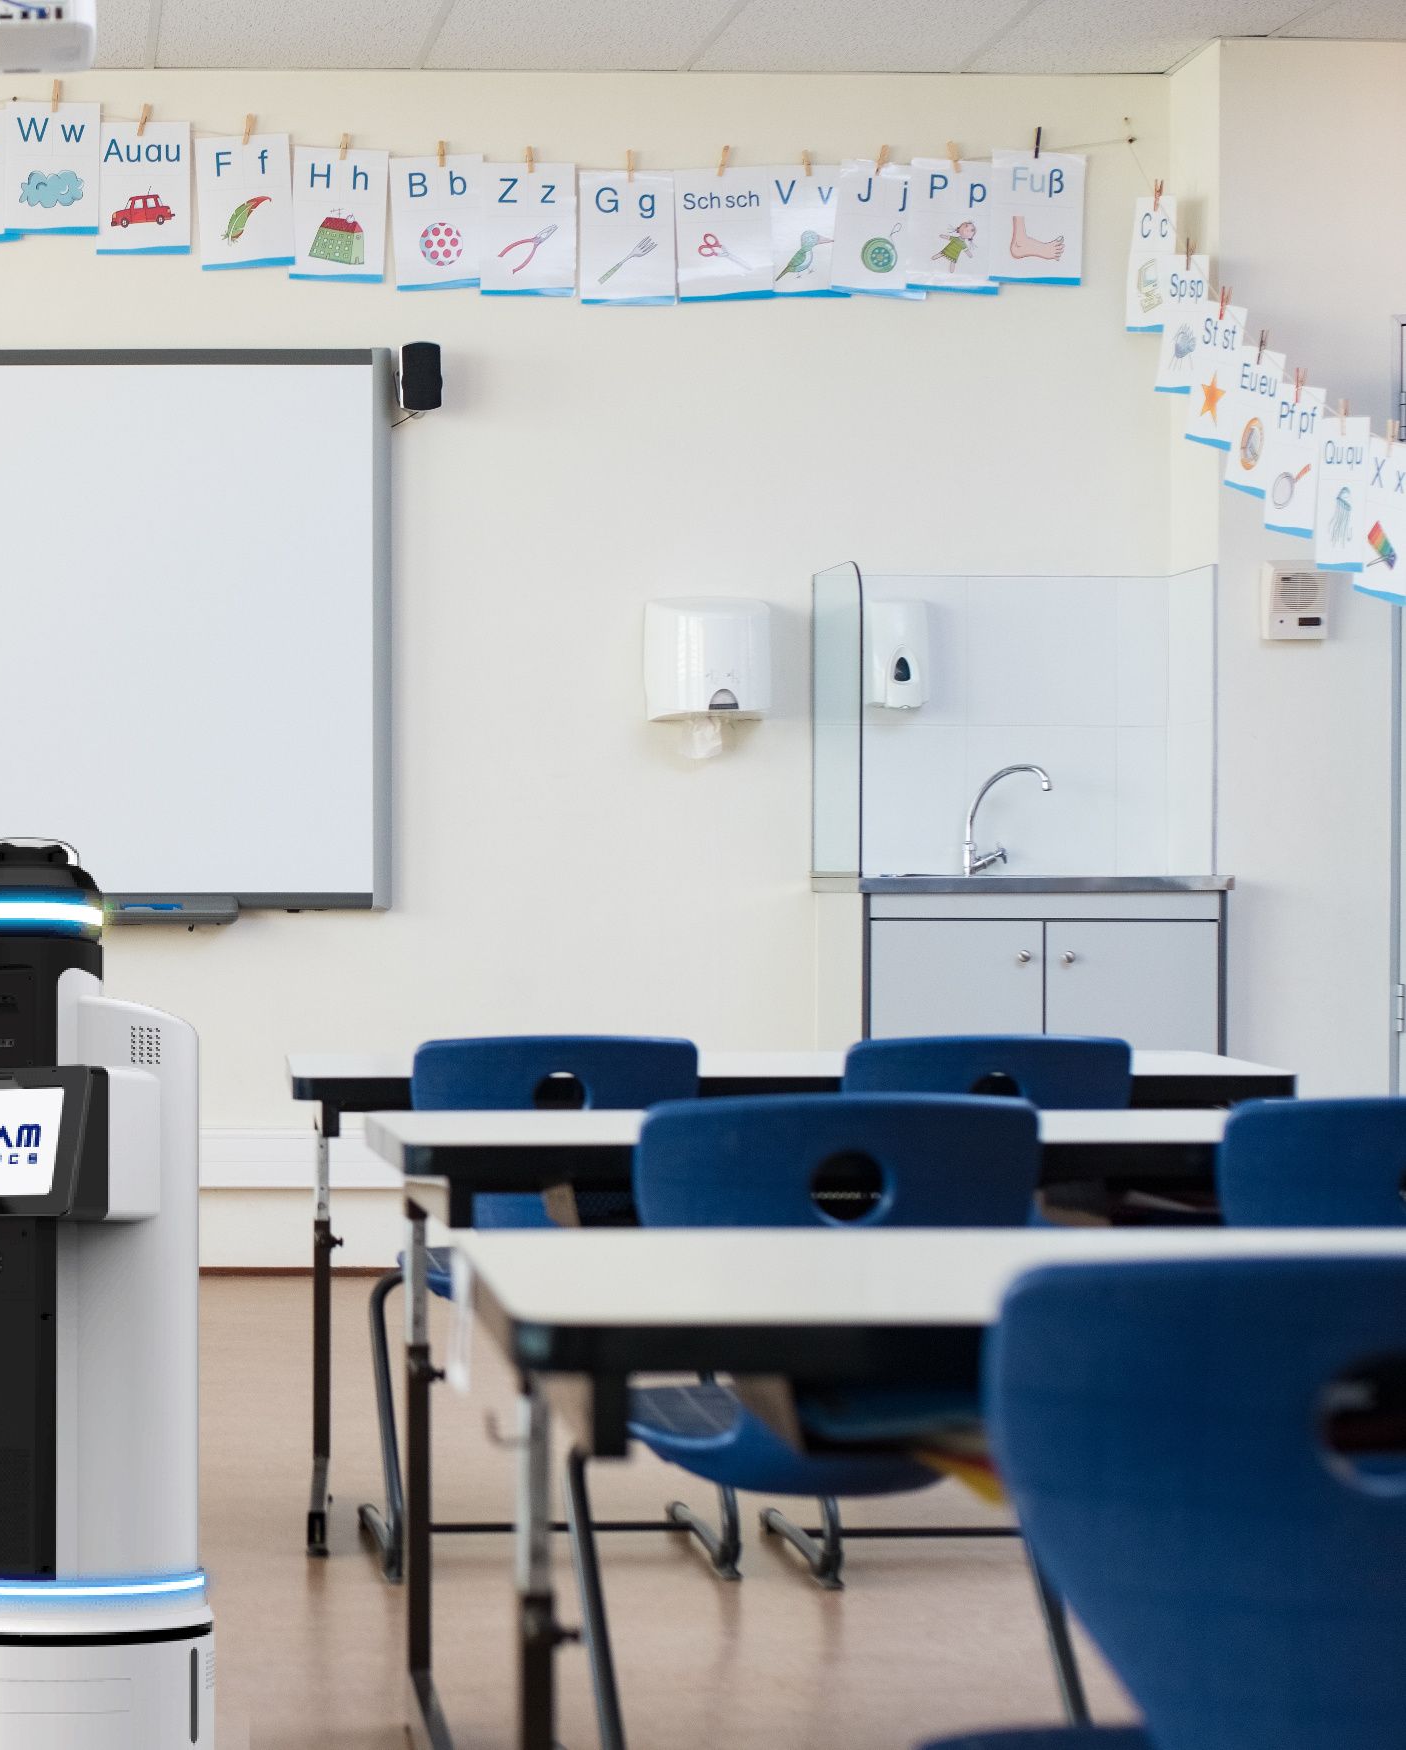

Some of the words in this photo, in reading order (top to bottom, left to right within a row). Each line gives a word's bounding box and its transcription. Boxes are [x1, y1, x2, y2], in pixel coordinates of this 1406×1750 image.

[17, 117, 49, 142] W
[61, 124, 85, 143] w
[216, 152, 231, 177] F
[258, 149, 268, 174] f
[310, 163, 331, 188] H
[353, 165, 368, 190] h
[408, 172, 427, 197] B
[449, 171, 466, 195] b
[498, 178, 518, 203] Z
[541, 185, 555, 203] z
[775, 180, 796, 204] V
[818, 186, 833, 204] v
[858, 178, 872, 202] J
[898, 181, 908, 212] j
[930, 174, 948, 199] P
[969, 183, 986, 208] p
[1013, 169, 1064, 198] Fuß
[596, 187, 618, 213] G
[639, 194, 655, 219] g
[1141, 213, 1152, 238] C
[1160, 219, 1167, 238] c
[1371, 456, 1386, 488] X
[1394, 470, 1406, 494] x
